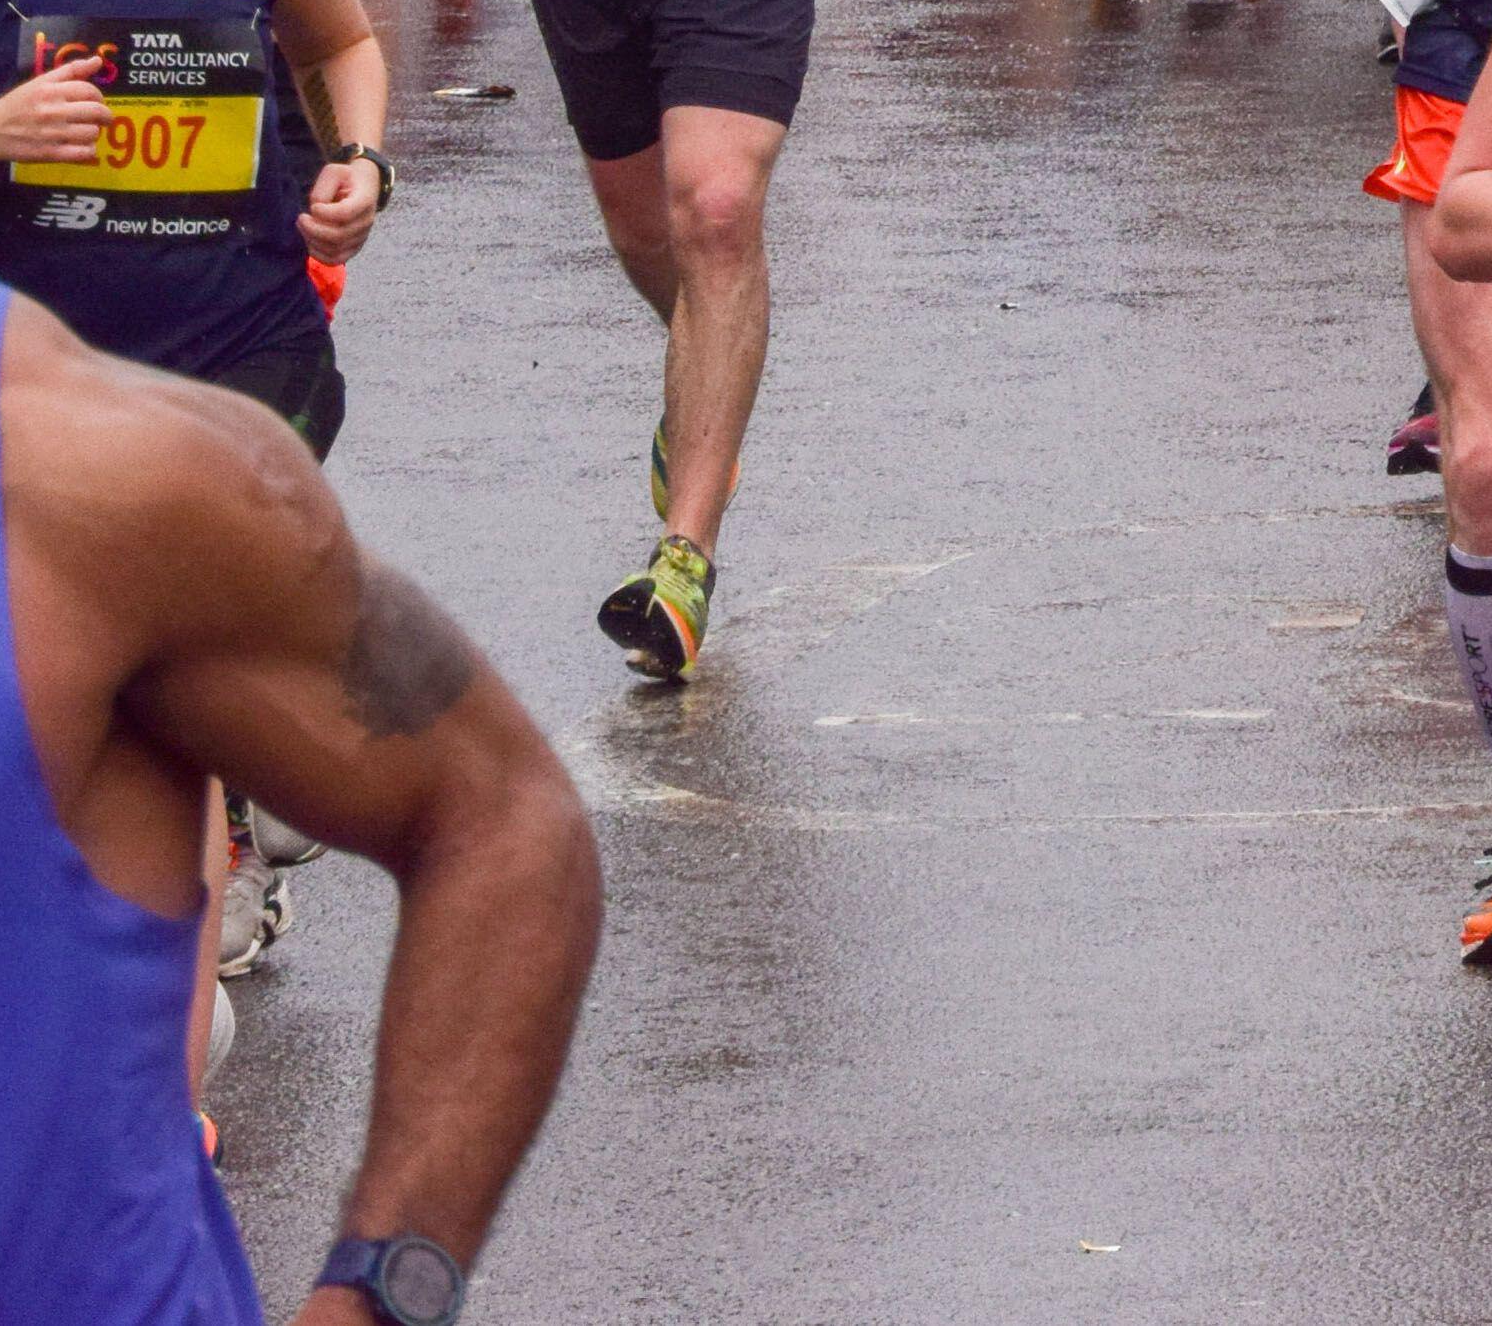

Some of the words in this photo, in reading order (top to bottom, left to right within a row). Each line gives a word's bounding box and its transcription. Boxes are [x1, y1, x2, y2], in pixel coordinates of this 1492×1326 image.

[130, 33, 182, 50] TATA
[130, 51, 250, 69] CONSULTANCY
[129, 70, 207, 86] SERVICES
[106, 216, 147, 234] new
[151, 215, 230, 235] balance
